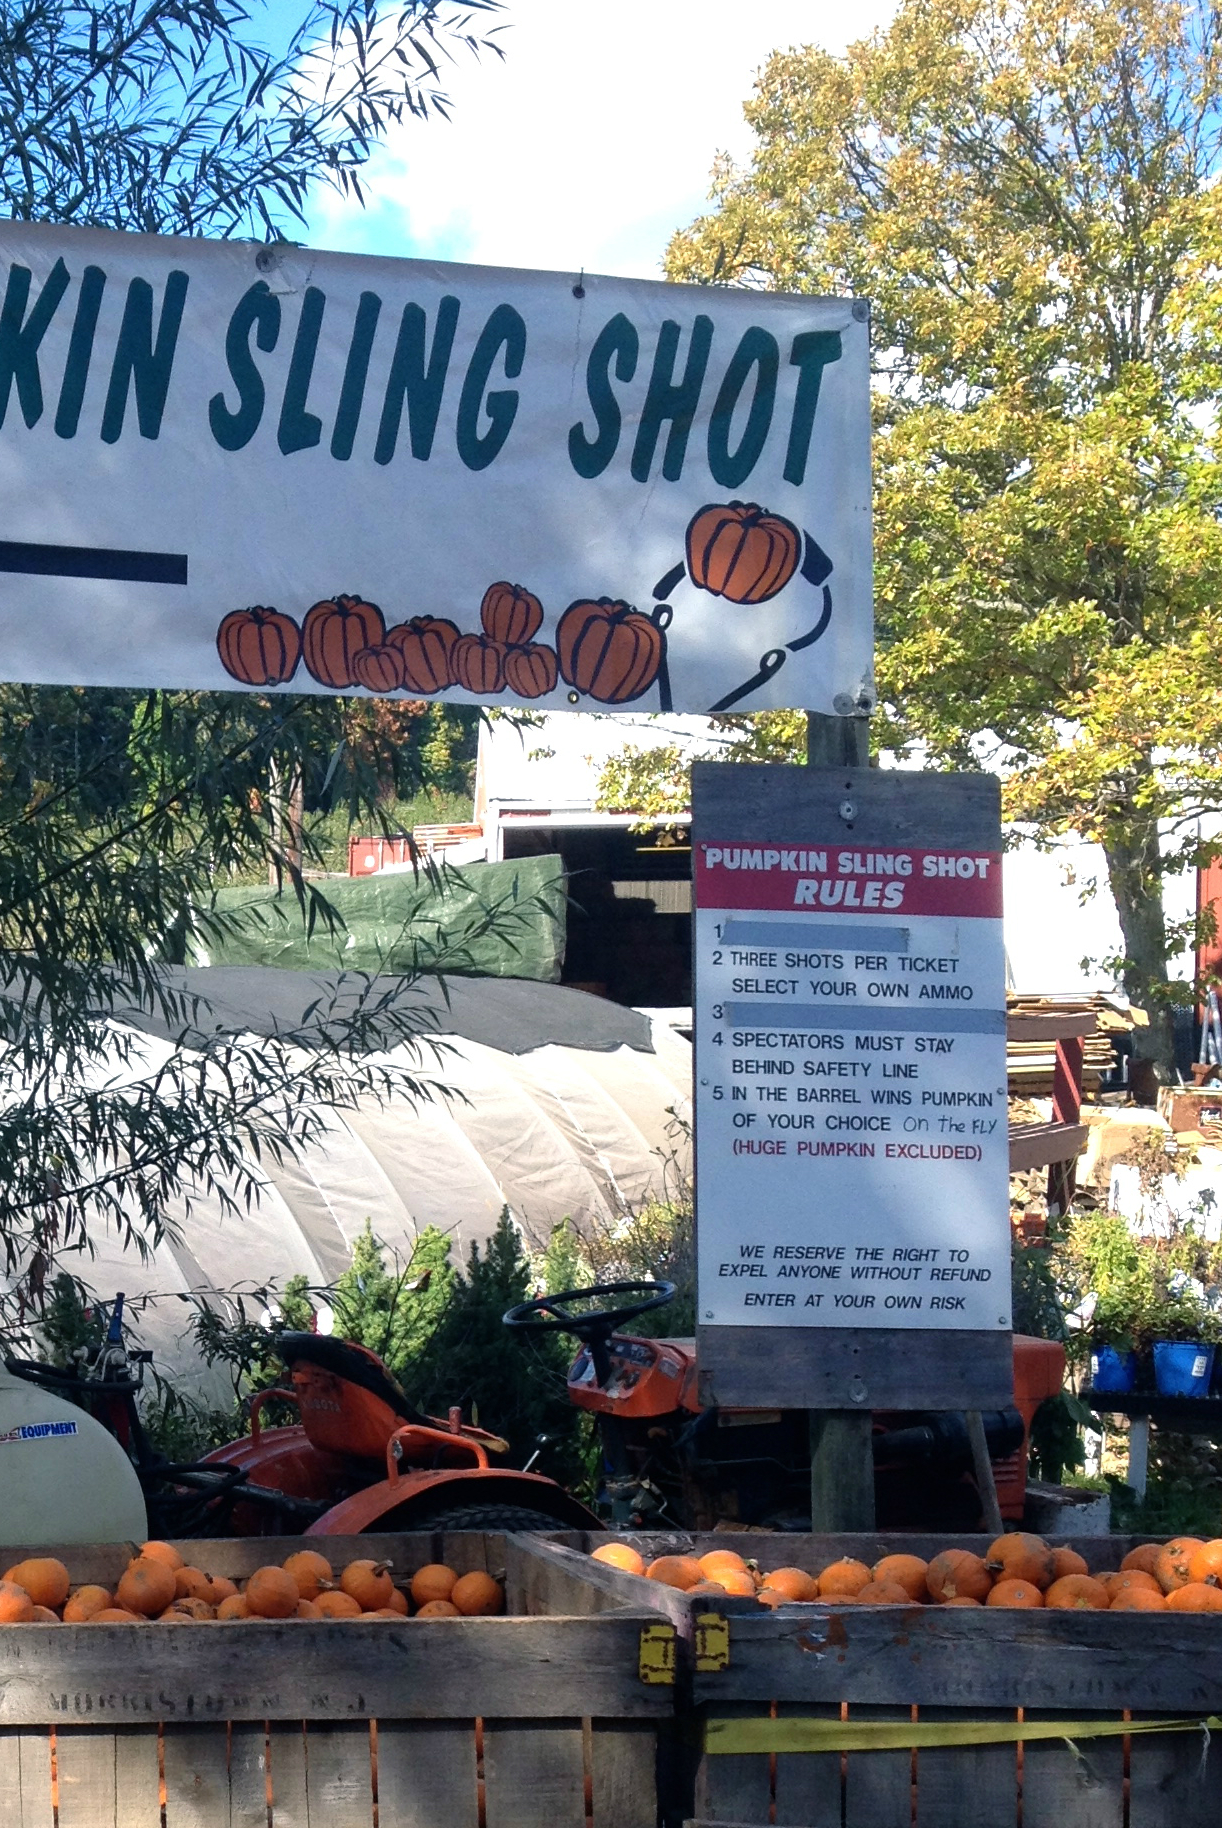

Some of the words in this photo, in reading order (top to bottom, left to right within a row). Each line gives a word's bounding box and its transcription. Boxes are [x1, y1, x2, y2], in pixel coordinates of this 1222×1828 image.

[209, 280, 527, 471] SLING
[568, 311, 844, 489] SHOT
[705, 848, 827, 873] PUMPKIN
[838, 852, 913, 876] SLING
[923, 856, 990, 879] SHOT
[794, 879, 906, 909] RULES
[714, 924, 722, 939] 1
[712, 951, 723, 966] 2
[731, 951, 777, 968] THREE
[785, 953, 844, 970] SHOTS
[855, 956, 888, 971] PER
[898, 957, 960, 974] TICKET
[732, 979, 799, 995] SELECT
[809, 981, 857, 997] YOUR
[867, 982, 909, 998] OWN
[919, 984, 973, 1001] AMMO
[712, 1005, 723, 1020] 3
[712, 1032, 723, 1047] 4
[732, 1032, 845, 1050] SPECTATORS
[855, 1036, 905, 1052] MUST
[915, 1037, 955, 1053] STAY
[732, 1060, 795, 1076] BEHIND
[803, 1061, 872, 1077] SAFETY
[883, 1064, 919, 1079] LINE
[712, 1087, 723, 1101] 5
[732, 1087, 747, 1101] IN
[756, 1087, 787, 1102] THE
[797, 1088, 861, 1104] BARREL
[871, 1090, 912, 1106] WINS
[922, 1091, 993, 1107] PUMPKIN
[732, 1113, 757, 1129] OF
[767, 1114, 815, 1130] YOUR
[825, 1115, 891, 1132] CHOICE
[938, 1117, 966, 1134] the
[972, 1119, 997, 1135] FLY
[732, 1139, 787, 1156] (HUGE
[797, 1141, 875, 1158] PUMPKIN
[885, 1144, 983, 1162] EXCLUDED)
[739, 1245, 765, 1259] WE
[773, 1246, 846, 1261] RESERVE
[855, 1247, 884, 1262] THE
[893, 1248, 940, 1263] RIGHT
[949, 1249, 970, 1264] TO
[718, 1264, 768, 1278] EXPEL
[778, 1265, 841, 1279] ANYONE
[850, 1267, 922, 1281] WITHOUT
[930, 1268, 992, 1282] REFUND
[744, 1293, 795, 1307] ENTER
[804, 1294, 824, 1307] AT
[834, 1295, 876, 1309] YOUR
[884, 1296, 923, 1310] OWN
[930, 1297, 966, 1311] RISK
[22, 1422, 77, 1439] EQUIPMENT
